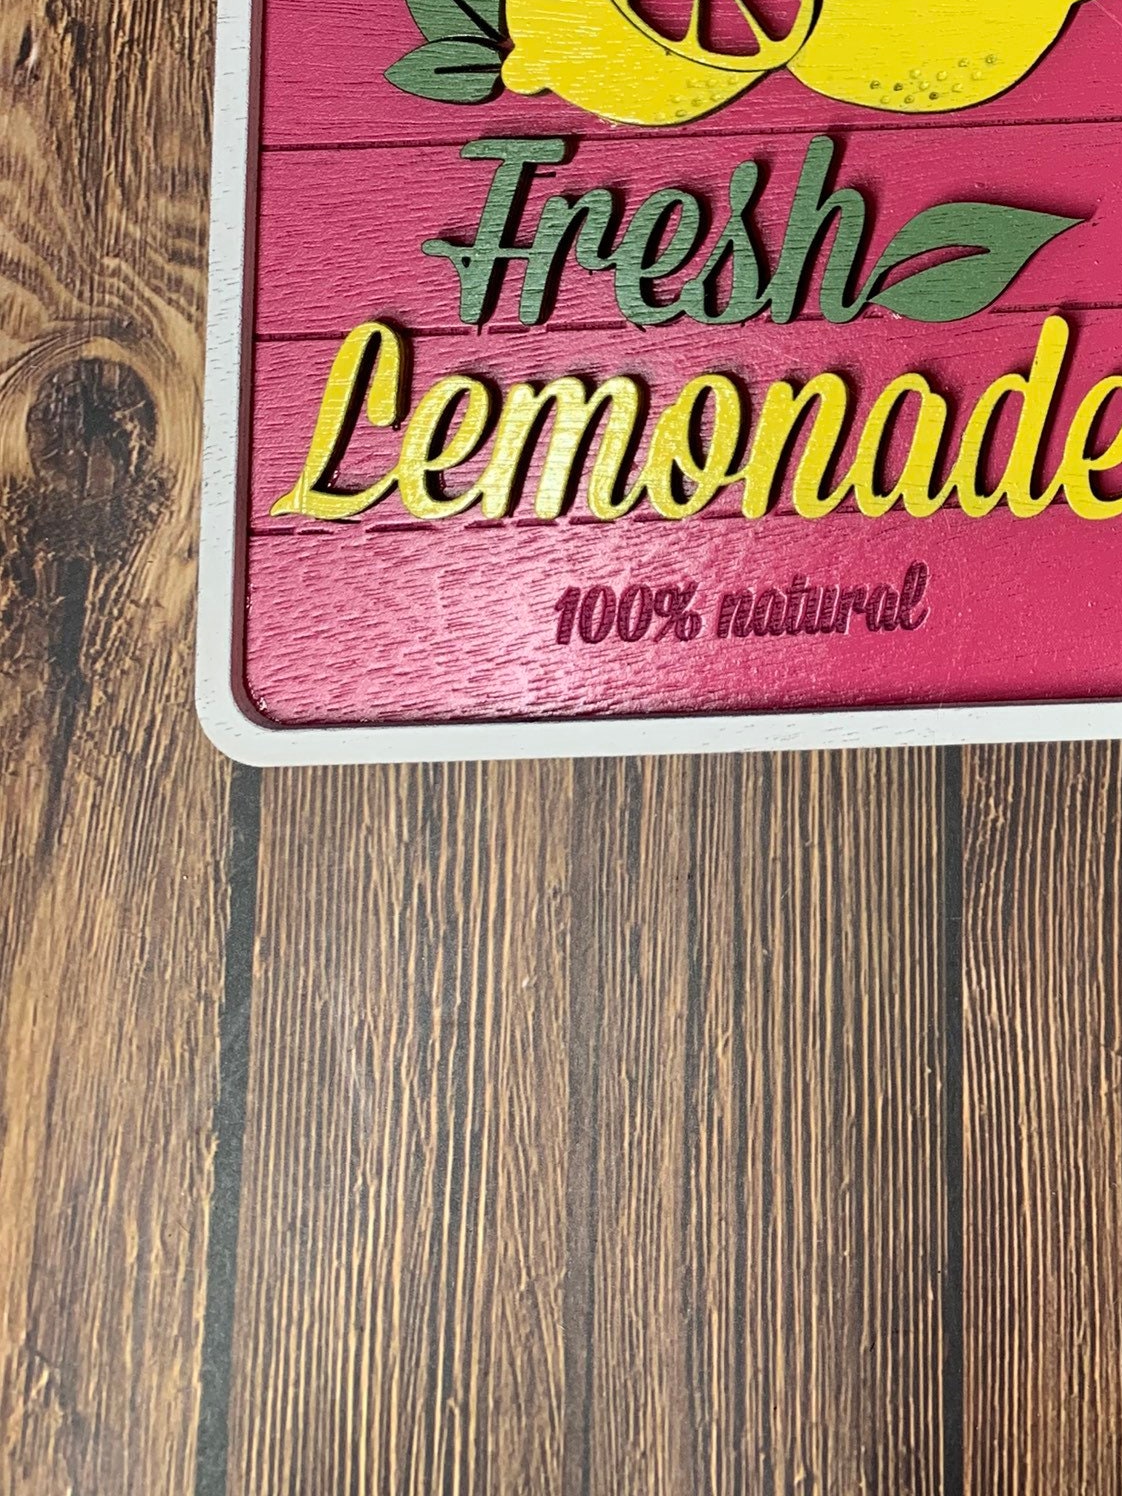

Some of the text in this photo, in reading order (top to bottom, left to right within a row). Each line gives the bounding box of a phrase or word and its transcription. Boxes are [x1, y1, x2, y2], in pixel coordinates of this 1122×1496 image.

[421, 134, 871, 326] Fresh
[553, 561, 929, 646] 100% natural
